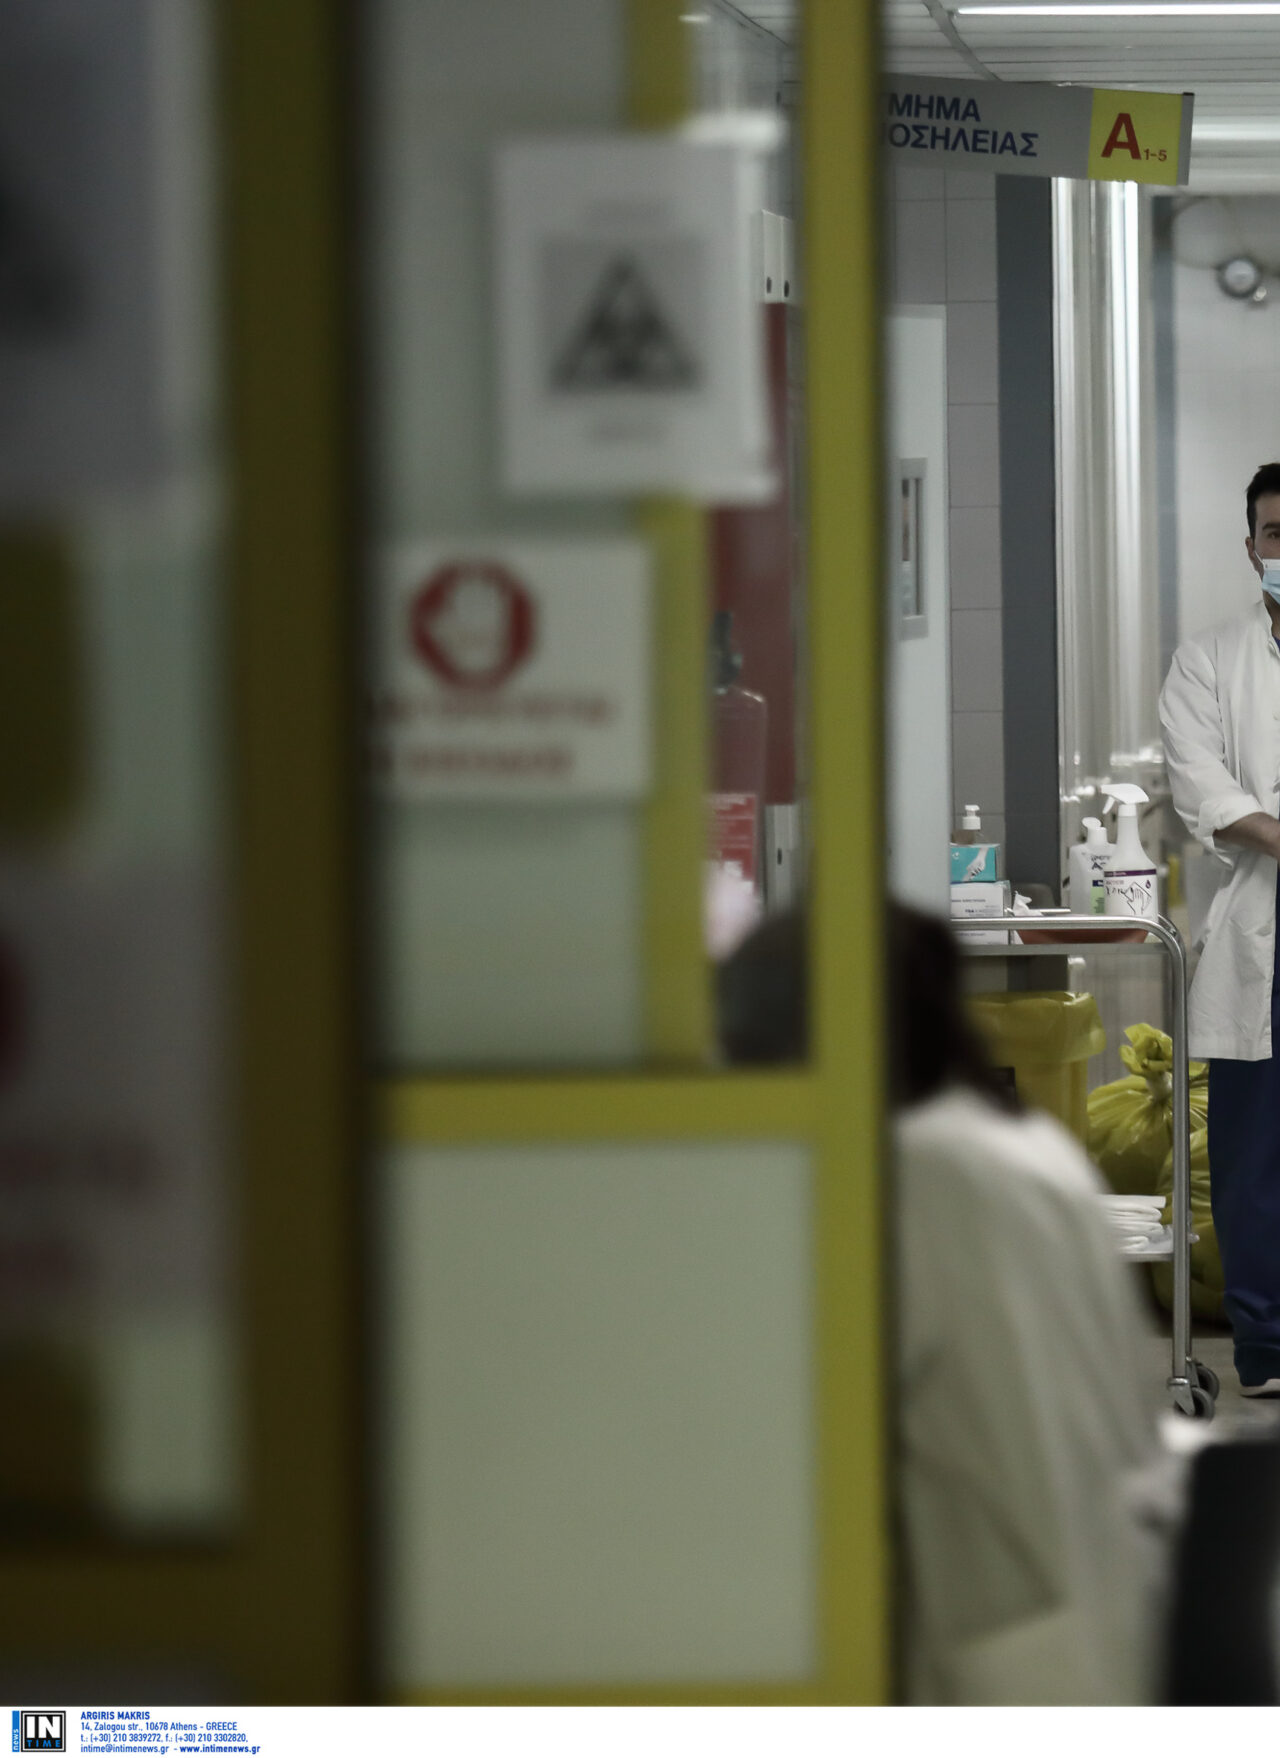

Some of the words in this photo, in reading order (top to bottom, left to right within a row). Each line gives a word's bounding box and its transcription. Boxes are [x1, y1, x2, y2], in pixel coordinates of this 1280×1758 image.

[882, 93, 981, 122] ΜΗΜΑ
[882, 123, 1039, 157] ΟΣΗΛΕΙΑΣ
[1101, 112, 1142, 161] Α
[1143, 148, 1168, 162] 1-5
